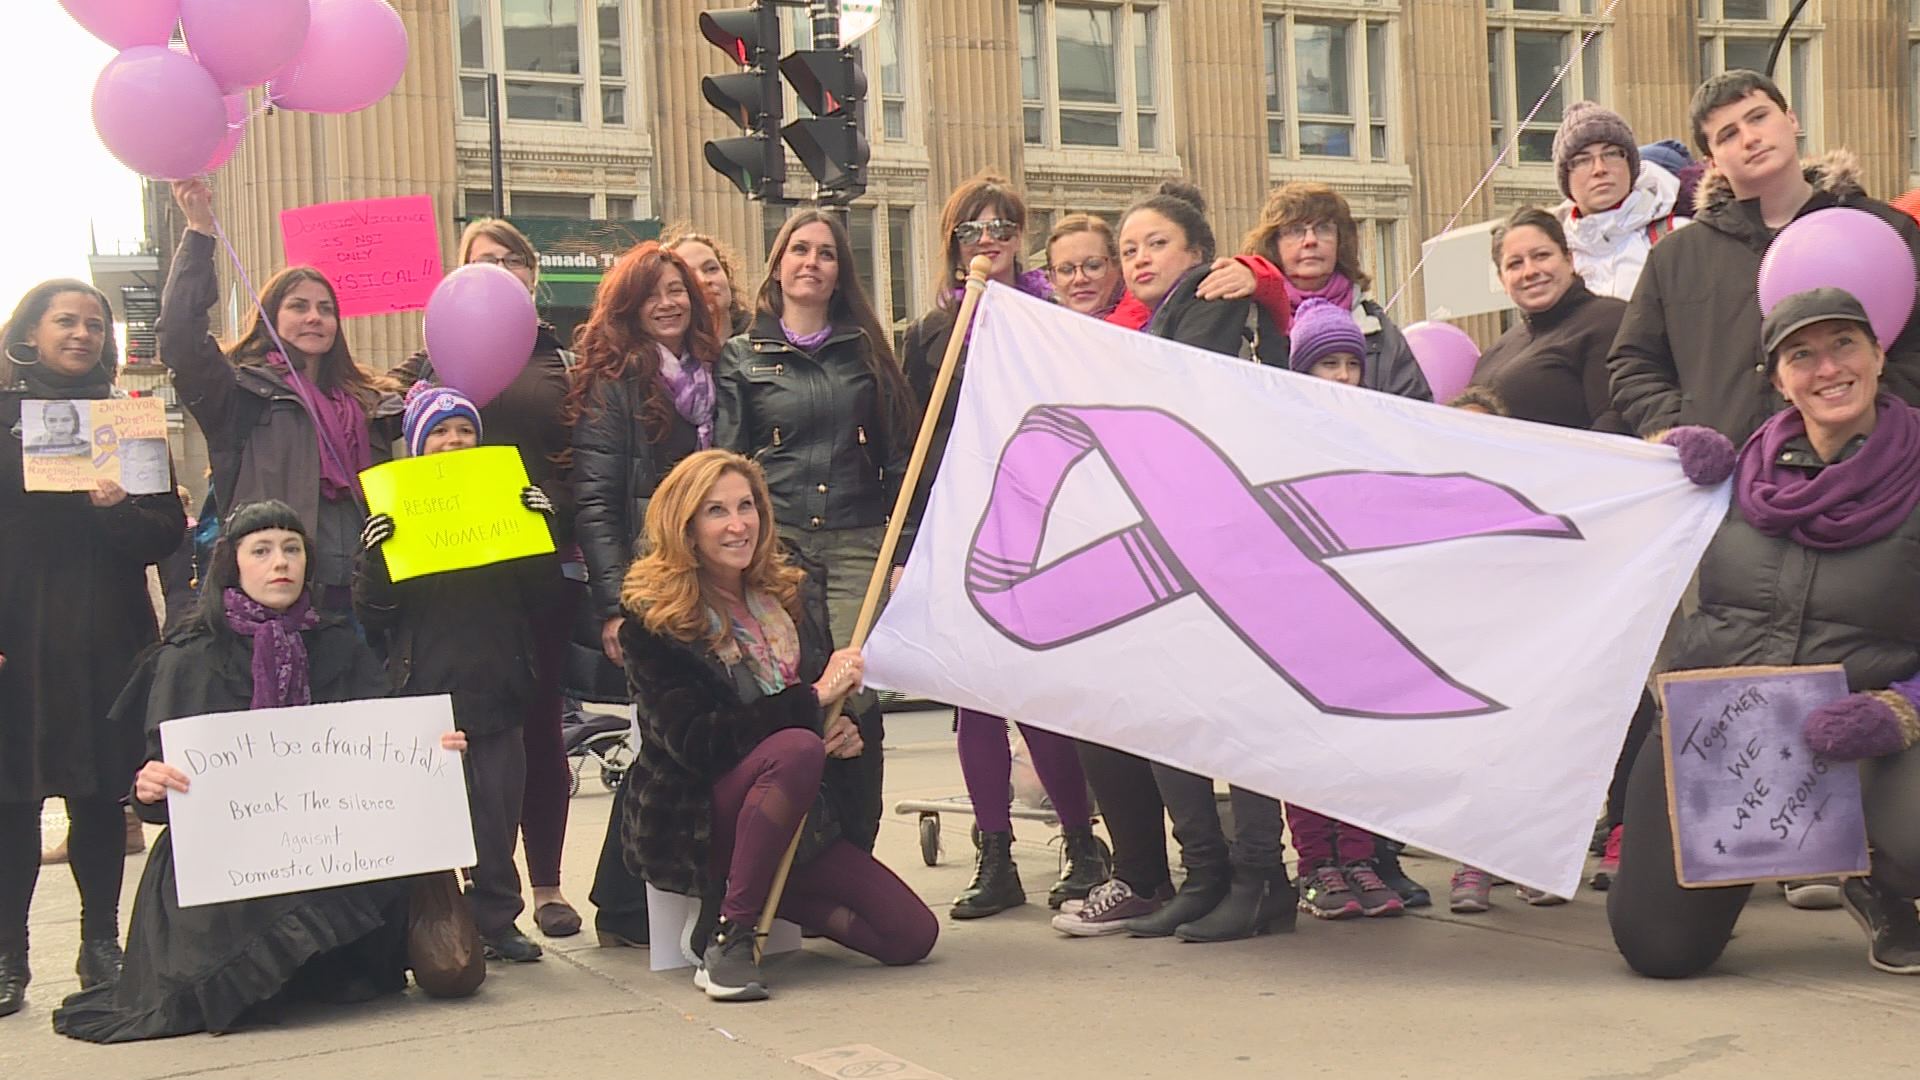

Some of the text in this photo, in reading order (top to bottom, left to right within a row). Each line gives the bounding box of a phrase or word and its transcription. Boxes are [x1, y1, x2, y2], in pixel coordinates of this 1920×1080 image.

[320, 233, 383, 248] IS NOT
[337, 250, 372, 262] ONLY
[334, 259, 433, 289] YSICAL!!
[435, 462, 444, 480] I
[403, 495, 461, 516] RESPECT
[425, 519, 520, 549] WOMEN!!!
[184, 733, 256, 776] Don't
[270, 731, 302, 757] be
[311, 727, 371, 757] afraid
[1727, 737, 1763, 780] WE
[229, 790, 395, 821] Break The silence
[1733, 777, 1770, 830] ARE
[1769, 755, 1830, 839] STRONG
[228, 850, 395, 888] Domestic Violence
